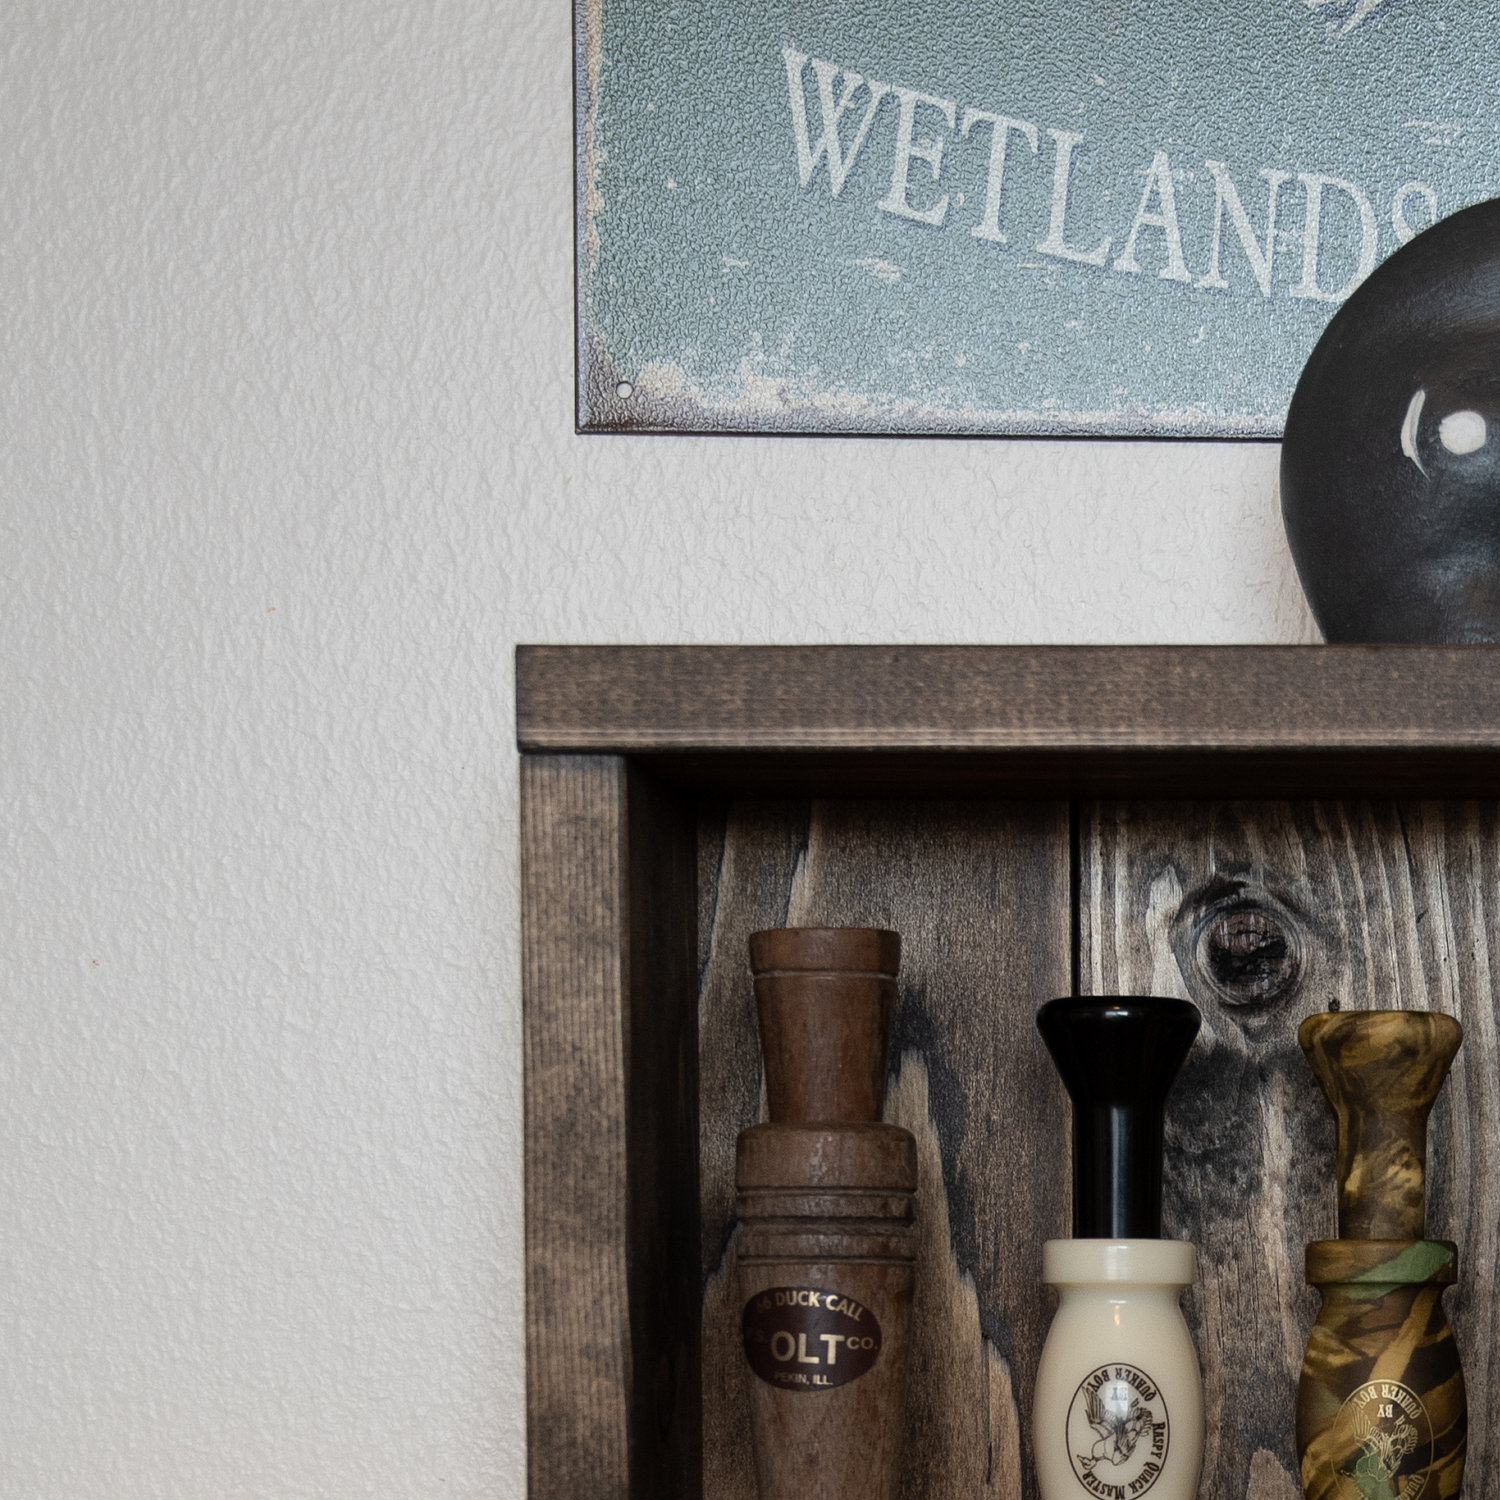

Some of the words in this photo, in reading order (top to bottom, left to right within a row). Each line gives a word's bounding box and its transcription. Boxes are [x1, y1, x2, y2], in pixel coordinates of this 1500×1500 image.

[775, 1290, 820, 1308] DUCK
[825, 1294, 863, 1322] CALL
[771, 1331, 845, 1365] OLT
[846, 1336, 878, 1350] CO.
[1086, 1368, 1111, 1393] BOY
[1114, 1367, 1157, 1402] QUAKER
[1353, 1385, 1378, 1409] BOY
[1377, 1403, 1394, 1418] BY
[1381, 1384, 1423, 1420] QUAKER
[1151, 1422, 1166, 1459] RASPY
[1082, 1470, 1126, 1500] MASTER
[1128, 1461, 1159, 1494] QUACK
